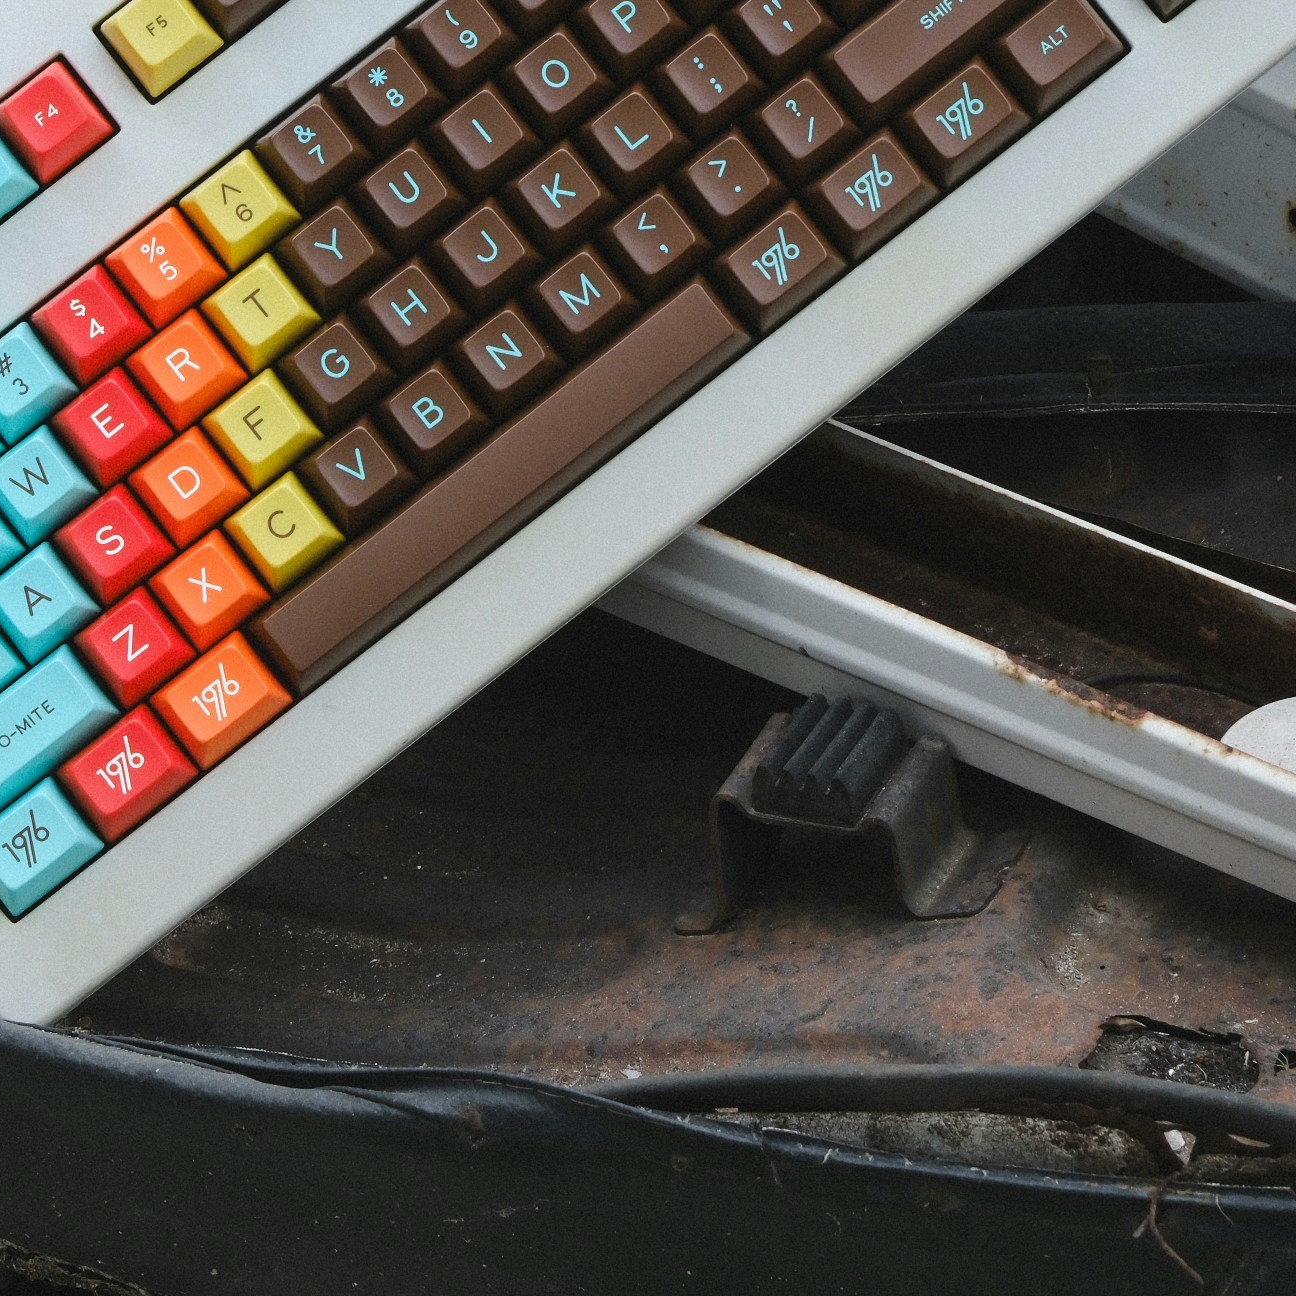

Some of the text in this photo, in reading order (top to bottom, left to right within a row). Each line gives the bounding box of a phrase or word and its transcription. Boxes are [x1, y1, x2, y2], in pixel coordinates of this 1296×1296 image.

[146, 15, 167, 36] F5
[612, 1, 635, 33] P
[460, 30, 477, 49] 9
[1041, 25, 1067, 55] ALT
[542, 60, 569, 88] O
[386, 89, 404, 107] 8
[786, 100, 801, 117] ?
[34, 104, 58, 126] F4
[294, 125, 316, 143] &
[614, 126, 649, 150] L
[308, 145, 324, 164] 7
[389, 171, 419, 203] U
[541, 173, 576, 208] K
[236, 203, 253, 222] 6
[140, 236, 166, 264] %
[314, 228, 343, 259] Y
[477, 231, 497, 262] J
[159, 261, 177, 281] 5
[70, 299, 86, 316] $
[242, 288, 268, 317] T
[391, 289, 427, 326] H
[559, 273, 600, 314] M
[90, 318, 104, 338] 4
[165, 348, 200, 381] R
[321, 349, 349, 378] G
[486, 333, 522, 370] N
[12, 378, 29, 395] 3
[91, 404, 124, 438] E
[243, 406, 263, 440] F
[412, 397, 443, 429] B
[9, 457, 49, 496] W
[336, 448, 365, 480] V
[168, 466, 200, 499] D
[268, 510, 296, 538] C
[96, 526, 124, 555] S
[188, 568, 222, 603] X
[24, 586, 52, 616] A
[112, 624, 149, 662] Z
